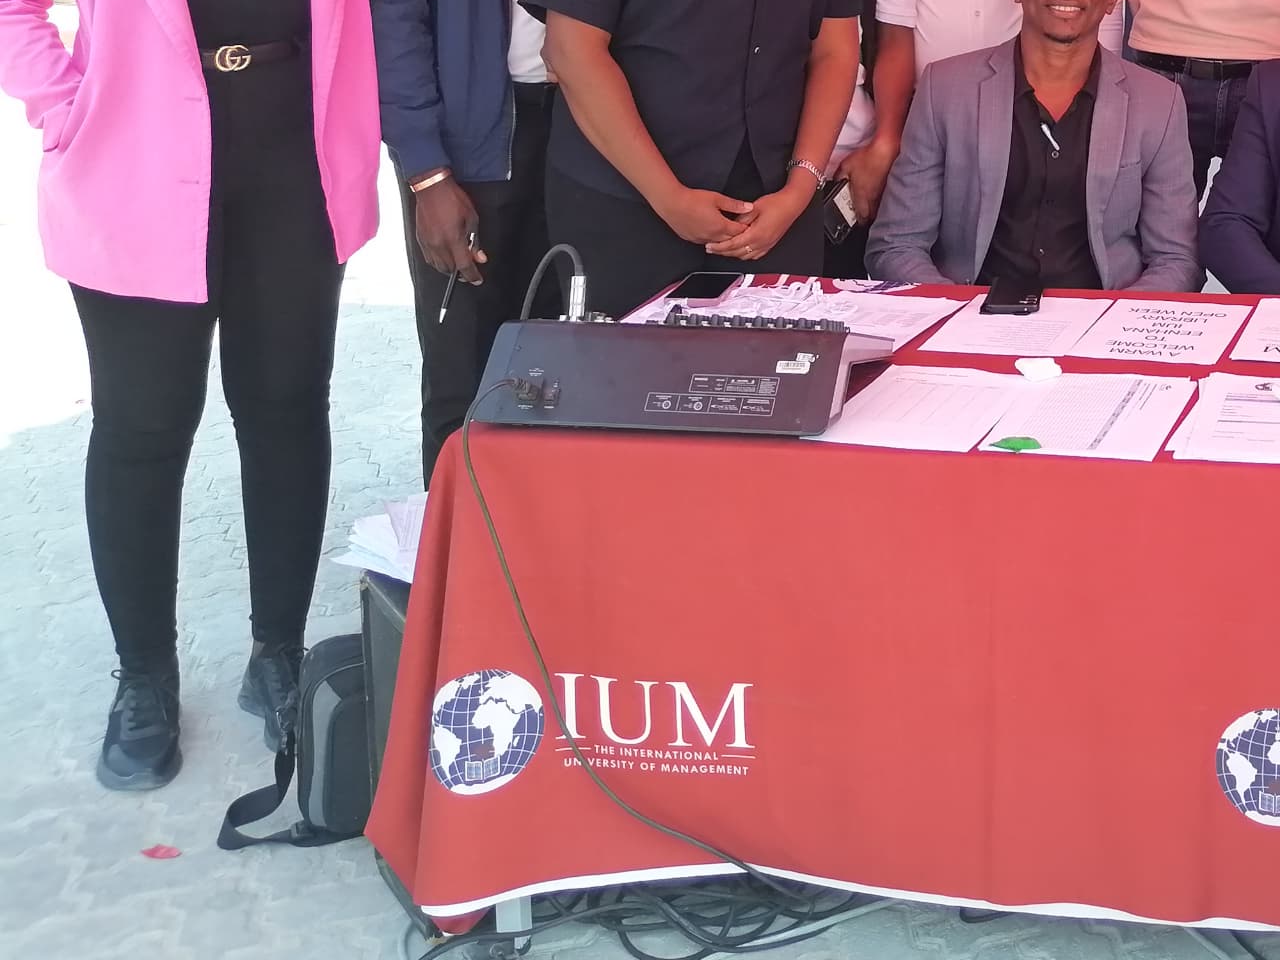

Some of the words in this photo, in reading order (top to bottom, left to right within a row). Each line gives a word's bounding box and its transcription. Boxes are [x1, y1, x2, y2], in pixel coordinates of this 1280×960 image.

[1128, 307, 1176, 315] WEEK
[1136, 314, 1208, 324] LIBRARY
[1122, 326, 1203, 337] EENHANA
[1106, 339, 1194, 351] WELCOME
[1109, 347, 1162, 356] WARM
[554, 672, 756, 749] IUM
[594, 744, 615, 755] THE
[619, 747, 719, 761] INTERNATIONAL
[563, 757, 634, 770] UNVERSITY
[640, 761, 656, 771] OF
[661, 762, 749, 776] MANAGEMENT
